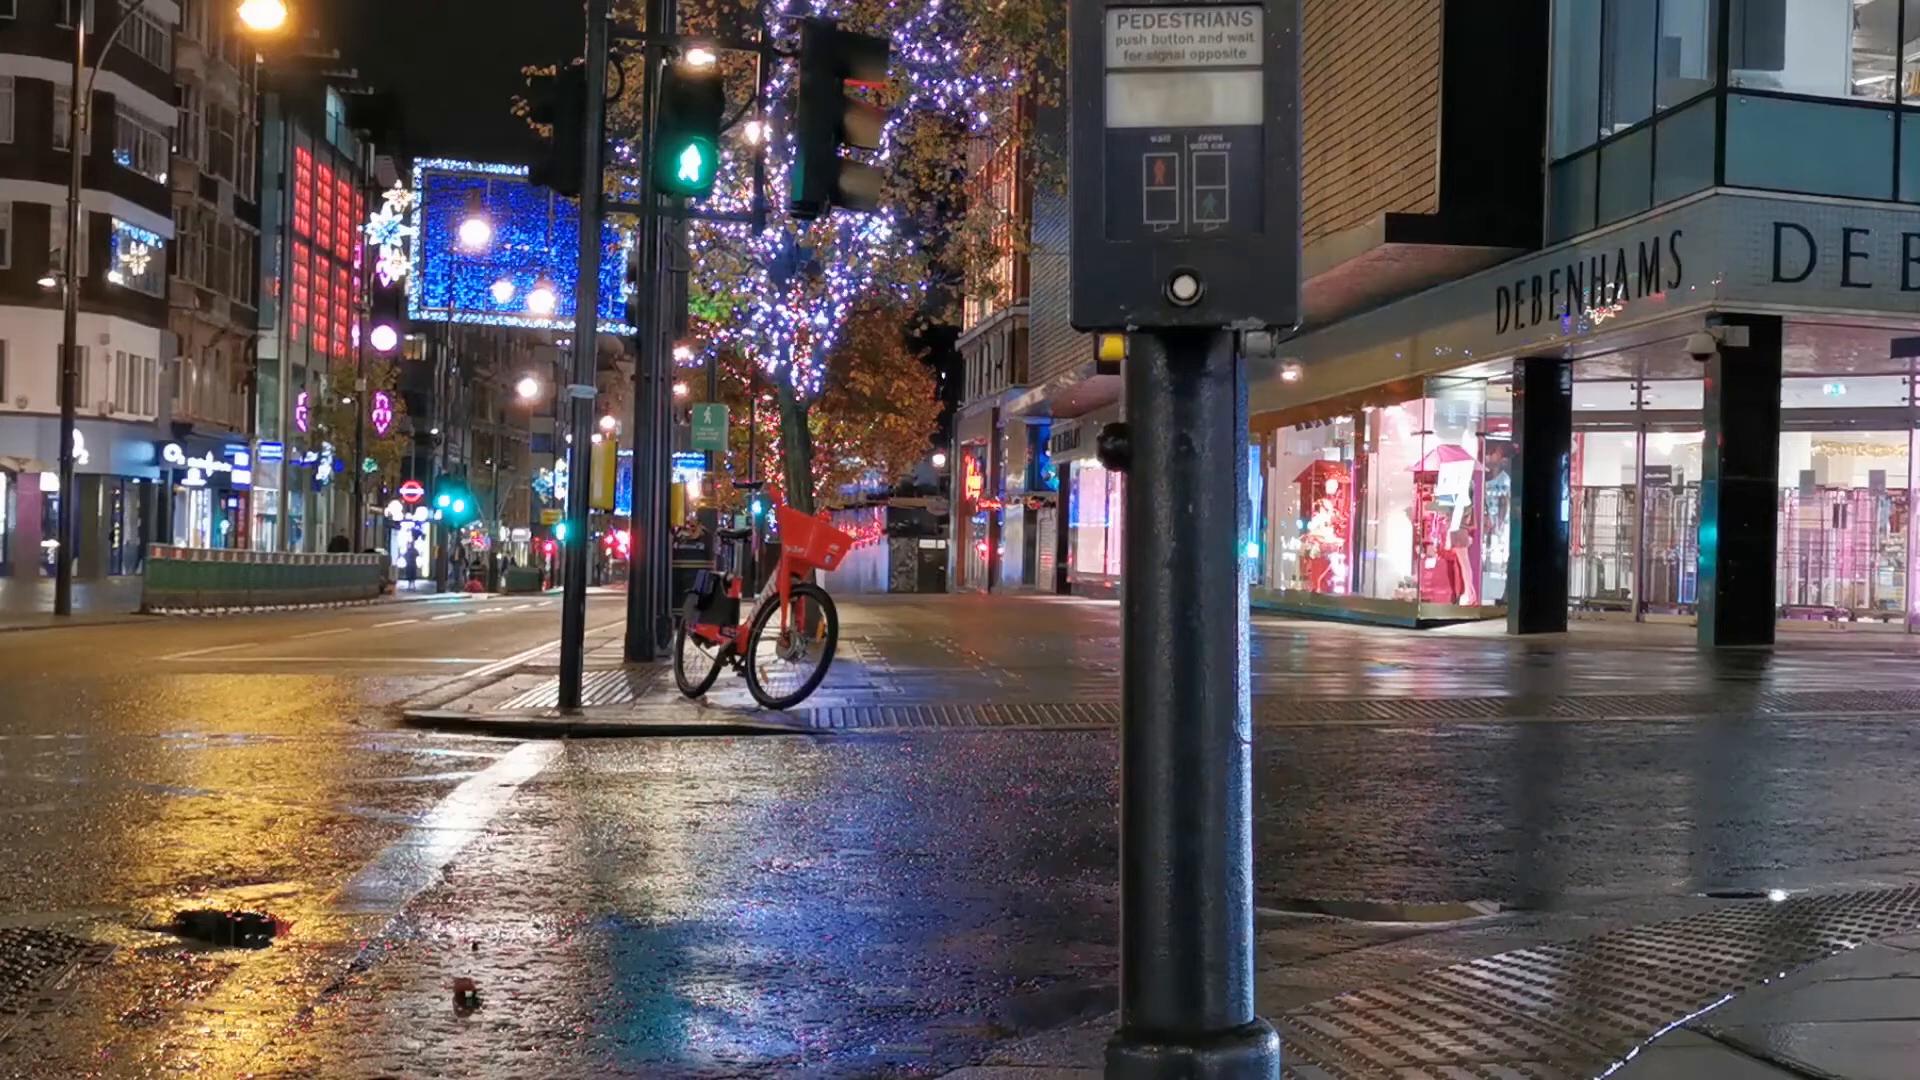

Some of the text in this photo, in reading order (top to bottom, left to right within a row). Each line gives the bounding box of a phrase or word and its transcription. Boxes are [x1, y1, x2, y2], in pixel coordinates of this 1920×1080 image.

[1117, 11, 1254, 30] PEDESTRIANS
[1115, 32, 1256, 47] push button and wait
[1123, 48, 1248, 63] for signal opposite
[1495, 229, 1682, 335] DEBENHAMS
